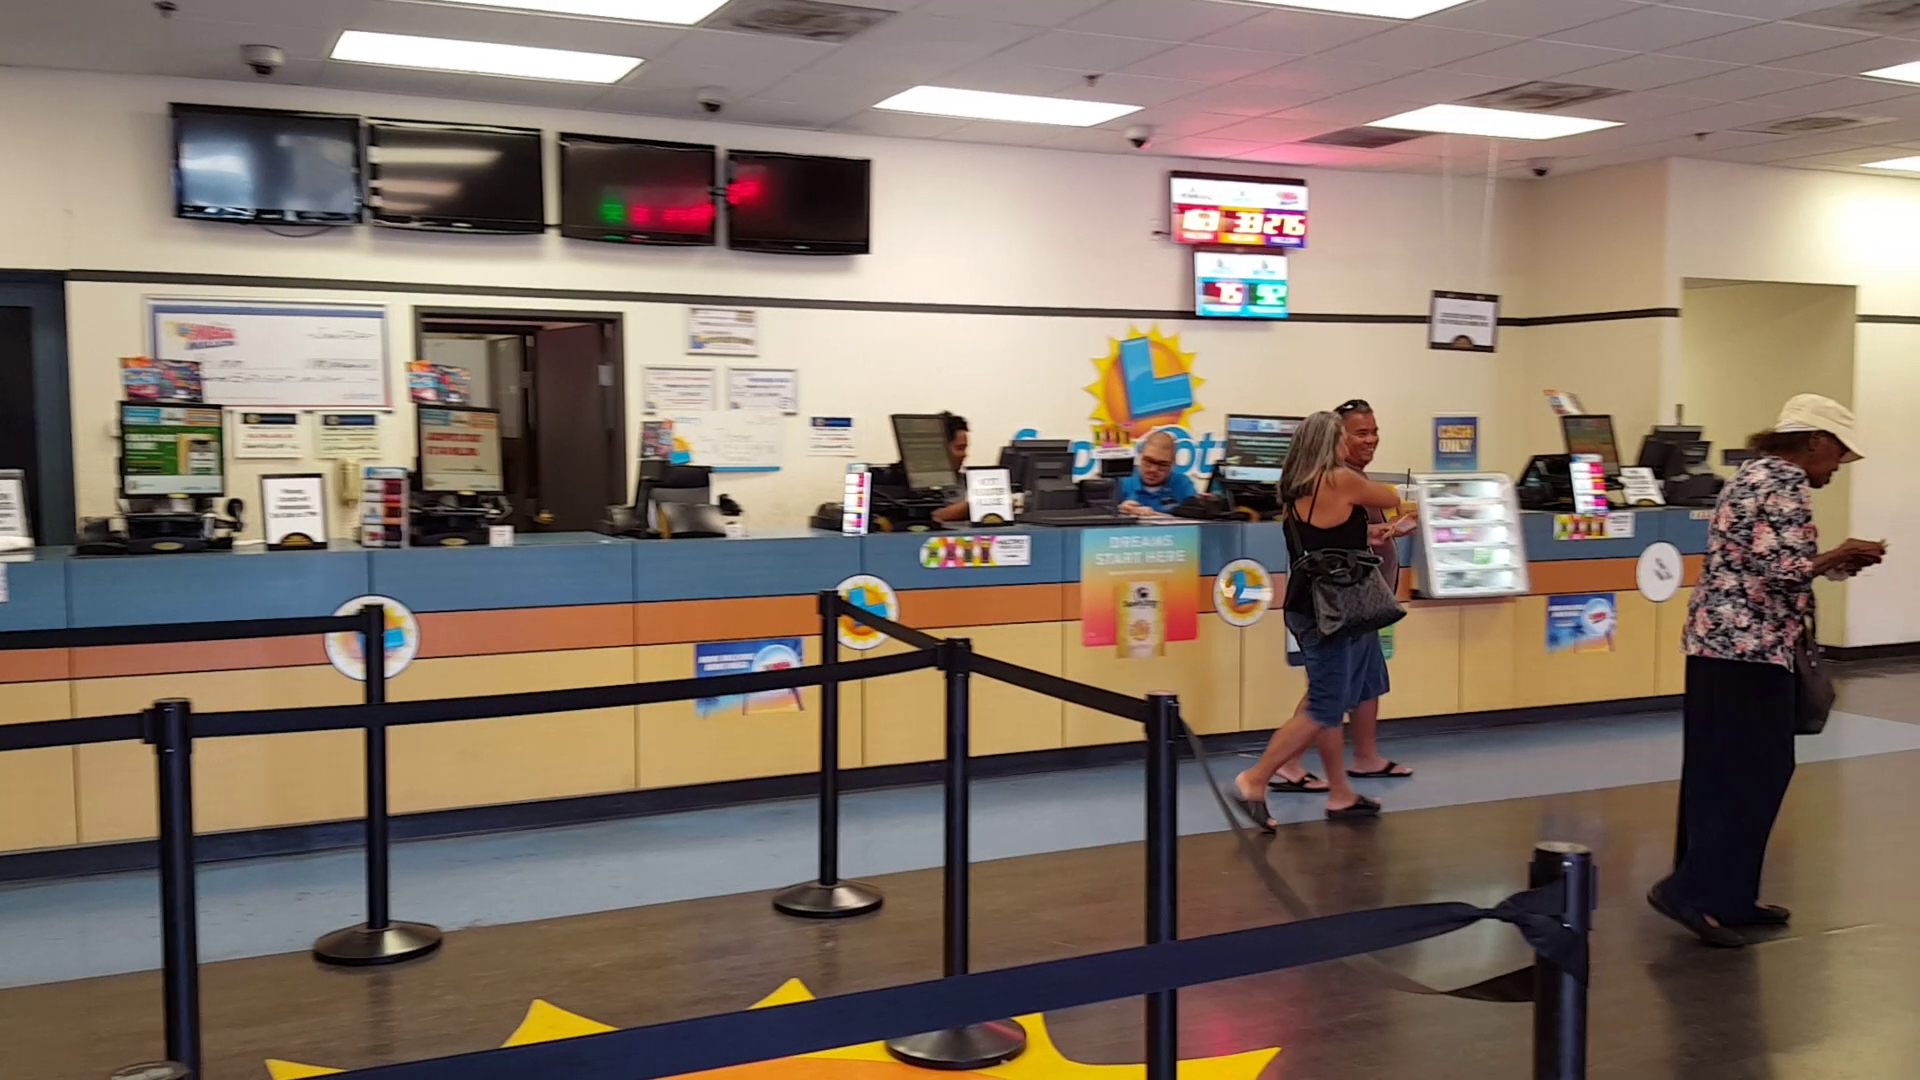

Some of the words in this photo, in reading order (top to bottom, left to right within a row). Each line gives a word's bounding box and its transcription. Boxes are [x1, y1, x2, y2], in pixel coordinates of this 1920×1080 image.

[1108, 534, 1174, 549] DREAMS
[1095, 551, 1143, 566] START
[1145, 549, 1187, 563] HERE
